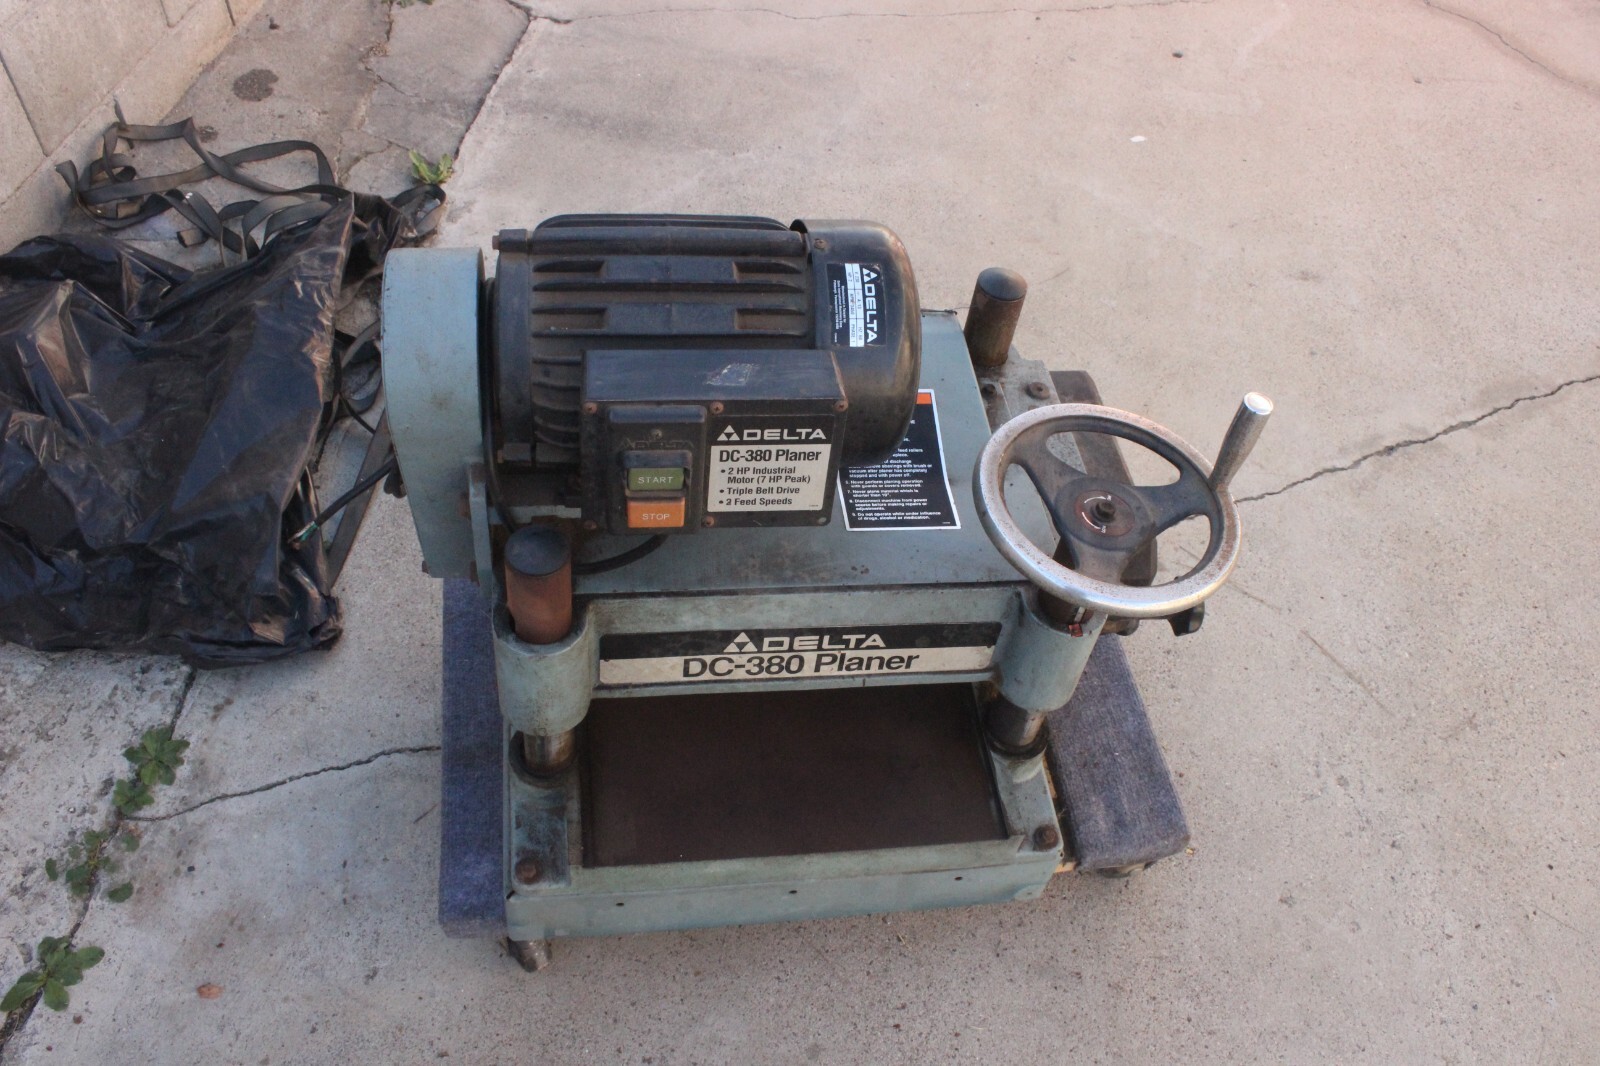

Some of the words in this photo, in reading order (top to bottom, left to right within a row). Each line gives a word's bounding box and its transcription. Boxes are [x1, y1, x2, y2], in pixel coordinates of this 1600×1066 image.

[864, 284, 878, 343] DELTA
[743, 429, 826, 440] DELTA
[720, 450, 772, 462] DC-380
[776, 449, 822, 461] Planer
[757, 476, 766, 484] (7
[785, 475, 811, 484] Peak)
[727, 487, 753, 496] Triple
[759, 498, 792, 506] Speeds
[762, 634, 886, 652] DELTA
[682, 654, 804, 678] DC-380
[813, 652, 919, 672] Planer
